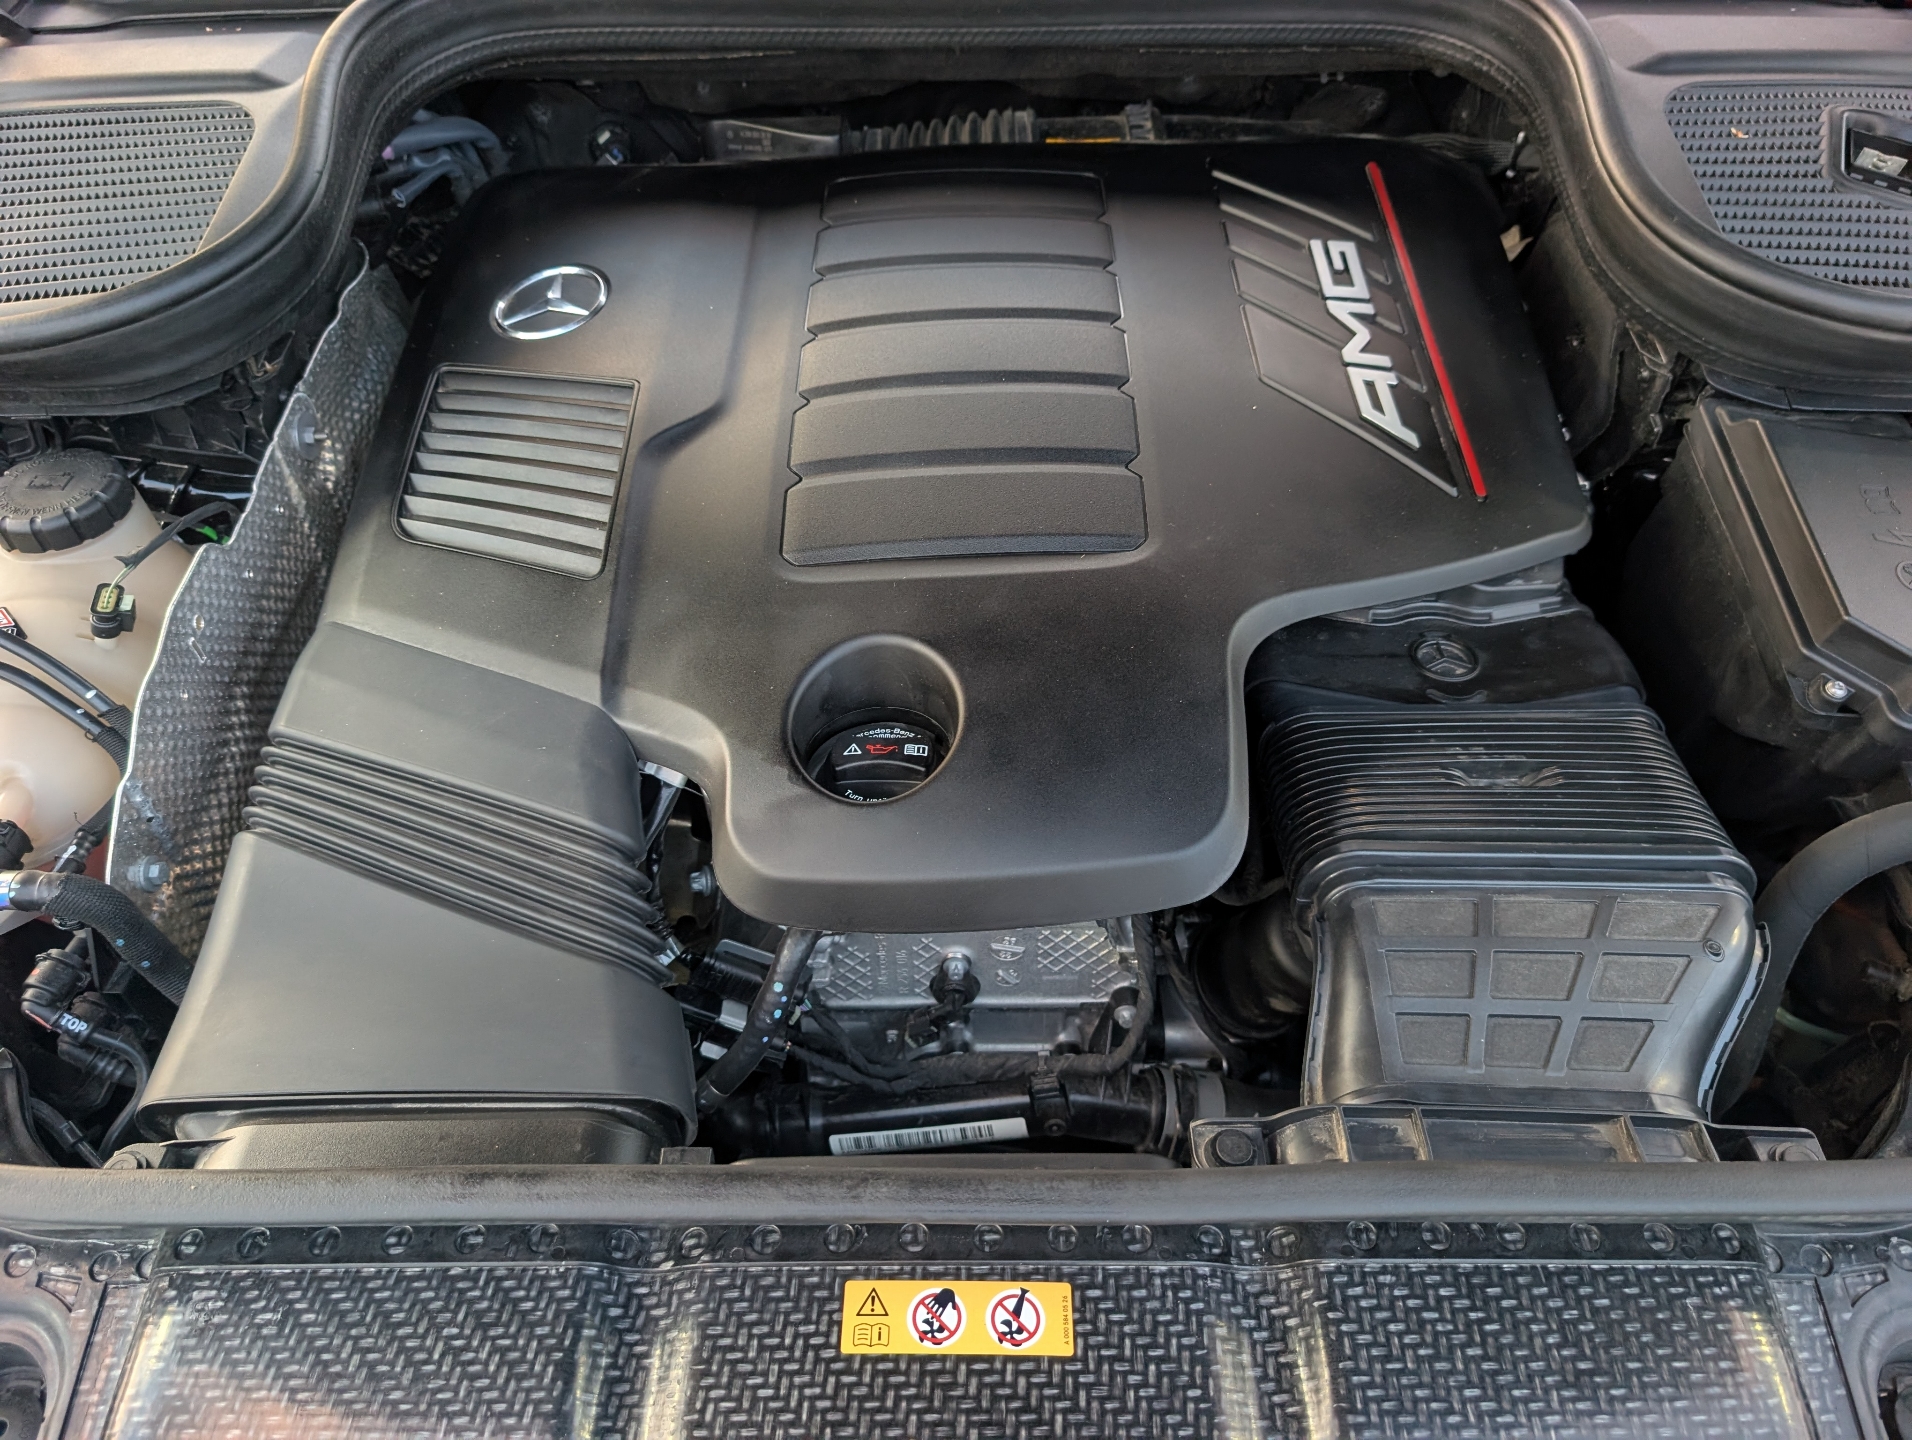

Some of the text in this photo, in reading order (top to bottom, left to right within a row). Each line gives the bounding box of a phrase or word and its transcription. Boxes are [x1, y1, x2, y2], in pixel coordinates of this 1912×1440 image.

[1309, 239, 1421, 450] AMG
[32, 502, 62, 515] WENN
[852, 727, 916, 738] rcedes-Benz
[844, 789, 864, 802] Turn
[60, 1012, 88, 1033] TOP
[1062, 1295, 1068, 1303] 26
[1062, 1304, 1068, 1313] 05
